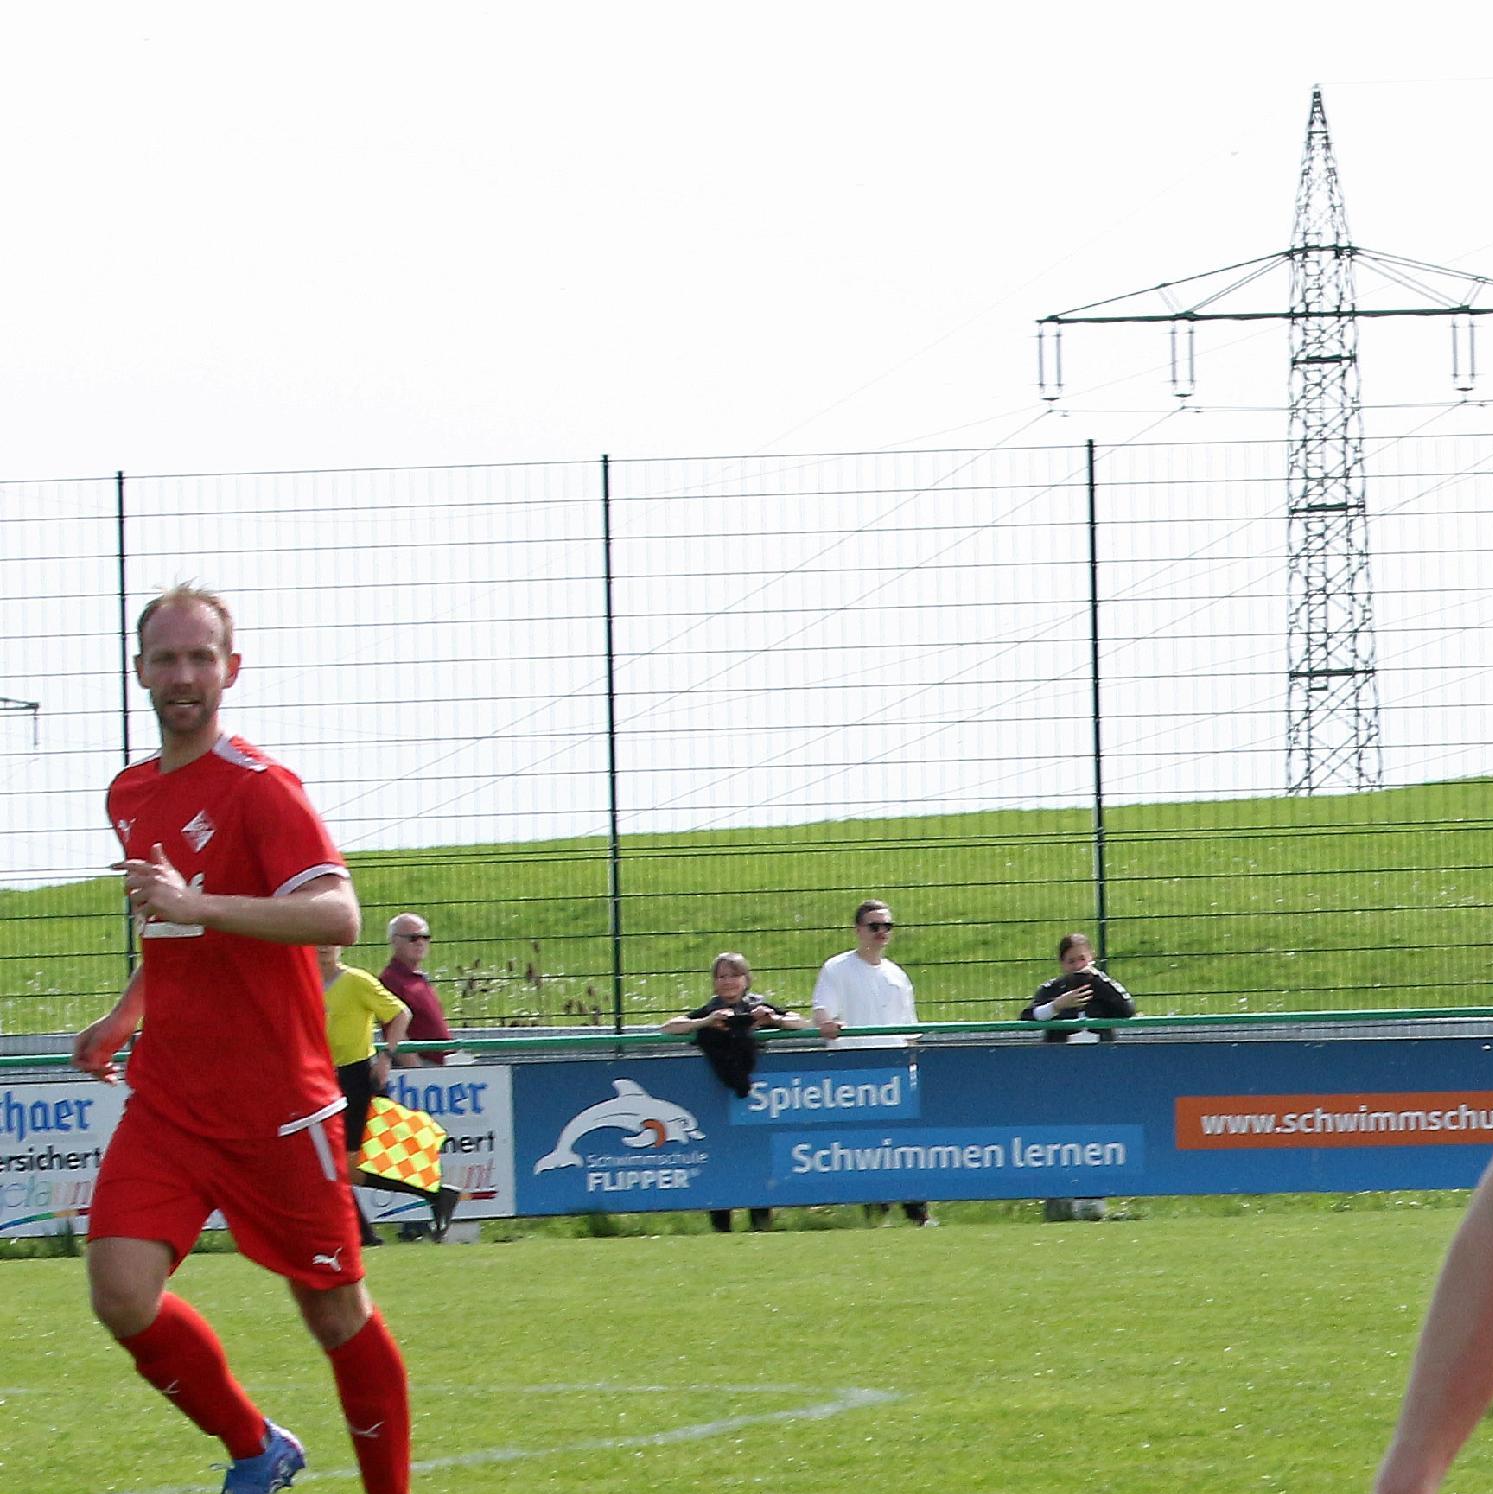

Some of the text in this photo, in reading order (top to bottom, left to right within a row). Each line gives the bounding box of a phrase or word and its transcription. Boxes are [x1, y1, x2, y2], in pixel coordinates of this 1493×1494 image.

[747, 1075, 901, 1118] Spielend
[791, 1135, 1127, 1174] Schwimmen lernen
[587, 1168, 690, 1193] FLIPPER
